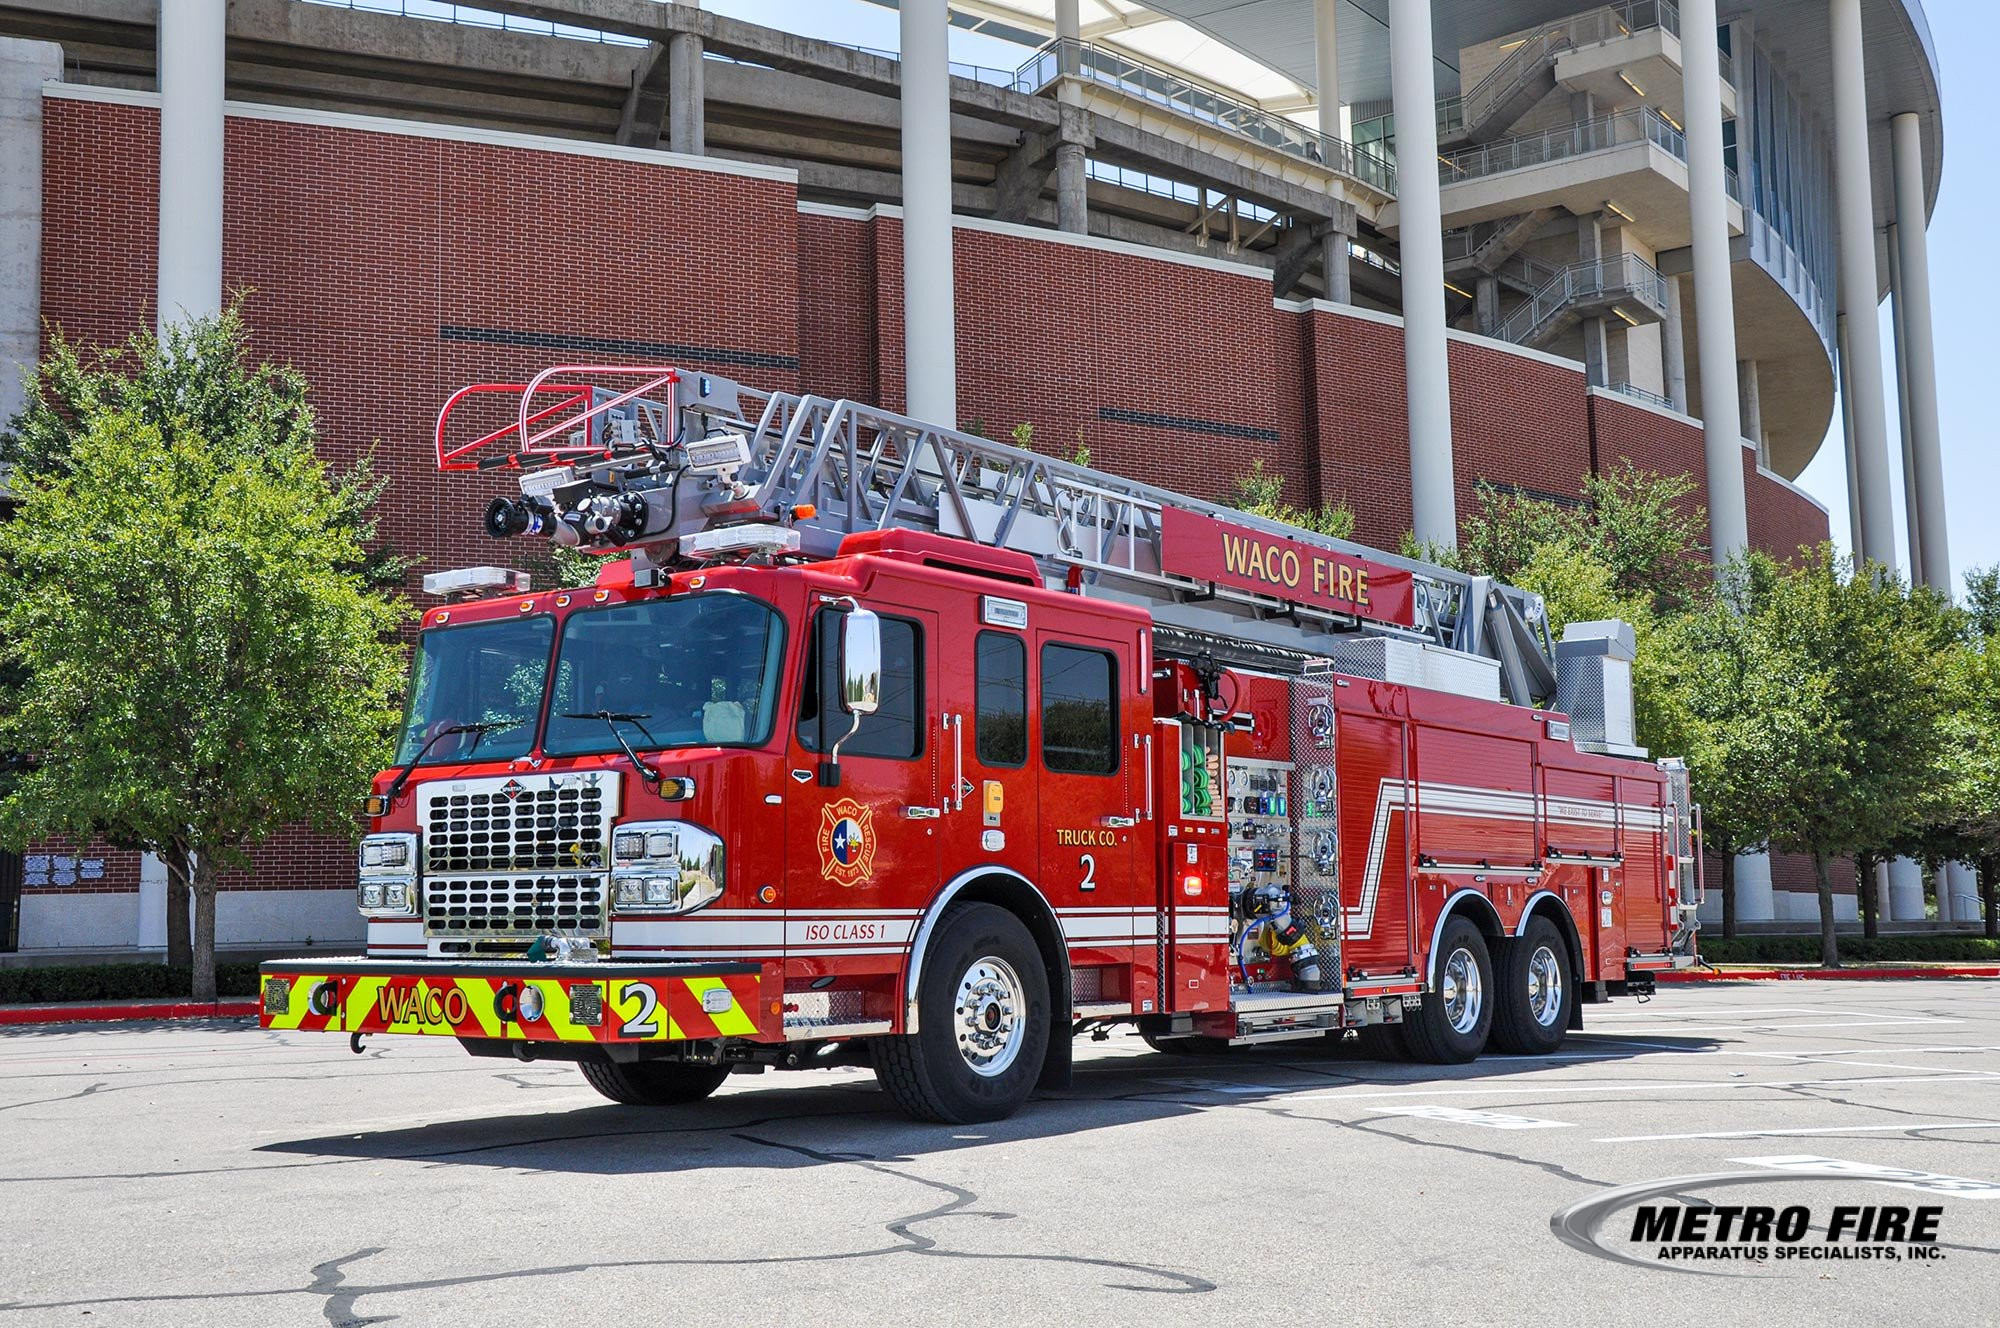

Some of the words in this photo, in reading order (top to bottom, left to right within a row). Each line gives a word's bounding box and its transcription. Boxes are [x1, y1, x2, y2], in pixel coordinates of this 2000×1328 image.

[1222, 533, 1300, 588] WACO
[1312, 556, 1369, 605] FIRE
[836, 806, 857, 816] WACO
[822, 828, 830, 853] FIRE
[862, 824, 872, 863] RESCUE
[1056, 829, 1096, 846] TRUCK
[1098, 830, 1118, 846] CO.
[834, 866, 847, 878] EST.
[1079, 853, 1096, 892] 2
[805, 924, 830, 940] ISO
[833, 924, 875, 940] CLASS
[880, 923, 886, 939] 1
[376, 985, 468, 1026] WACO
[618, 982, 659, 1038] 2
